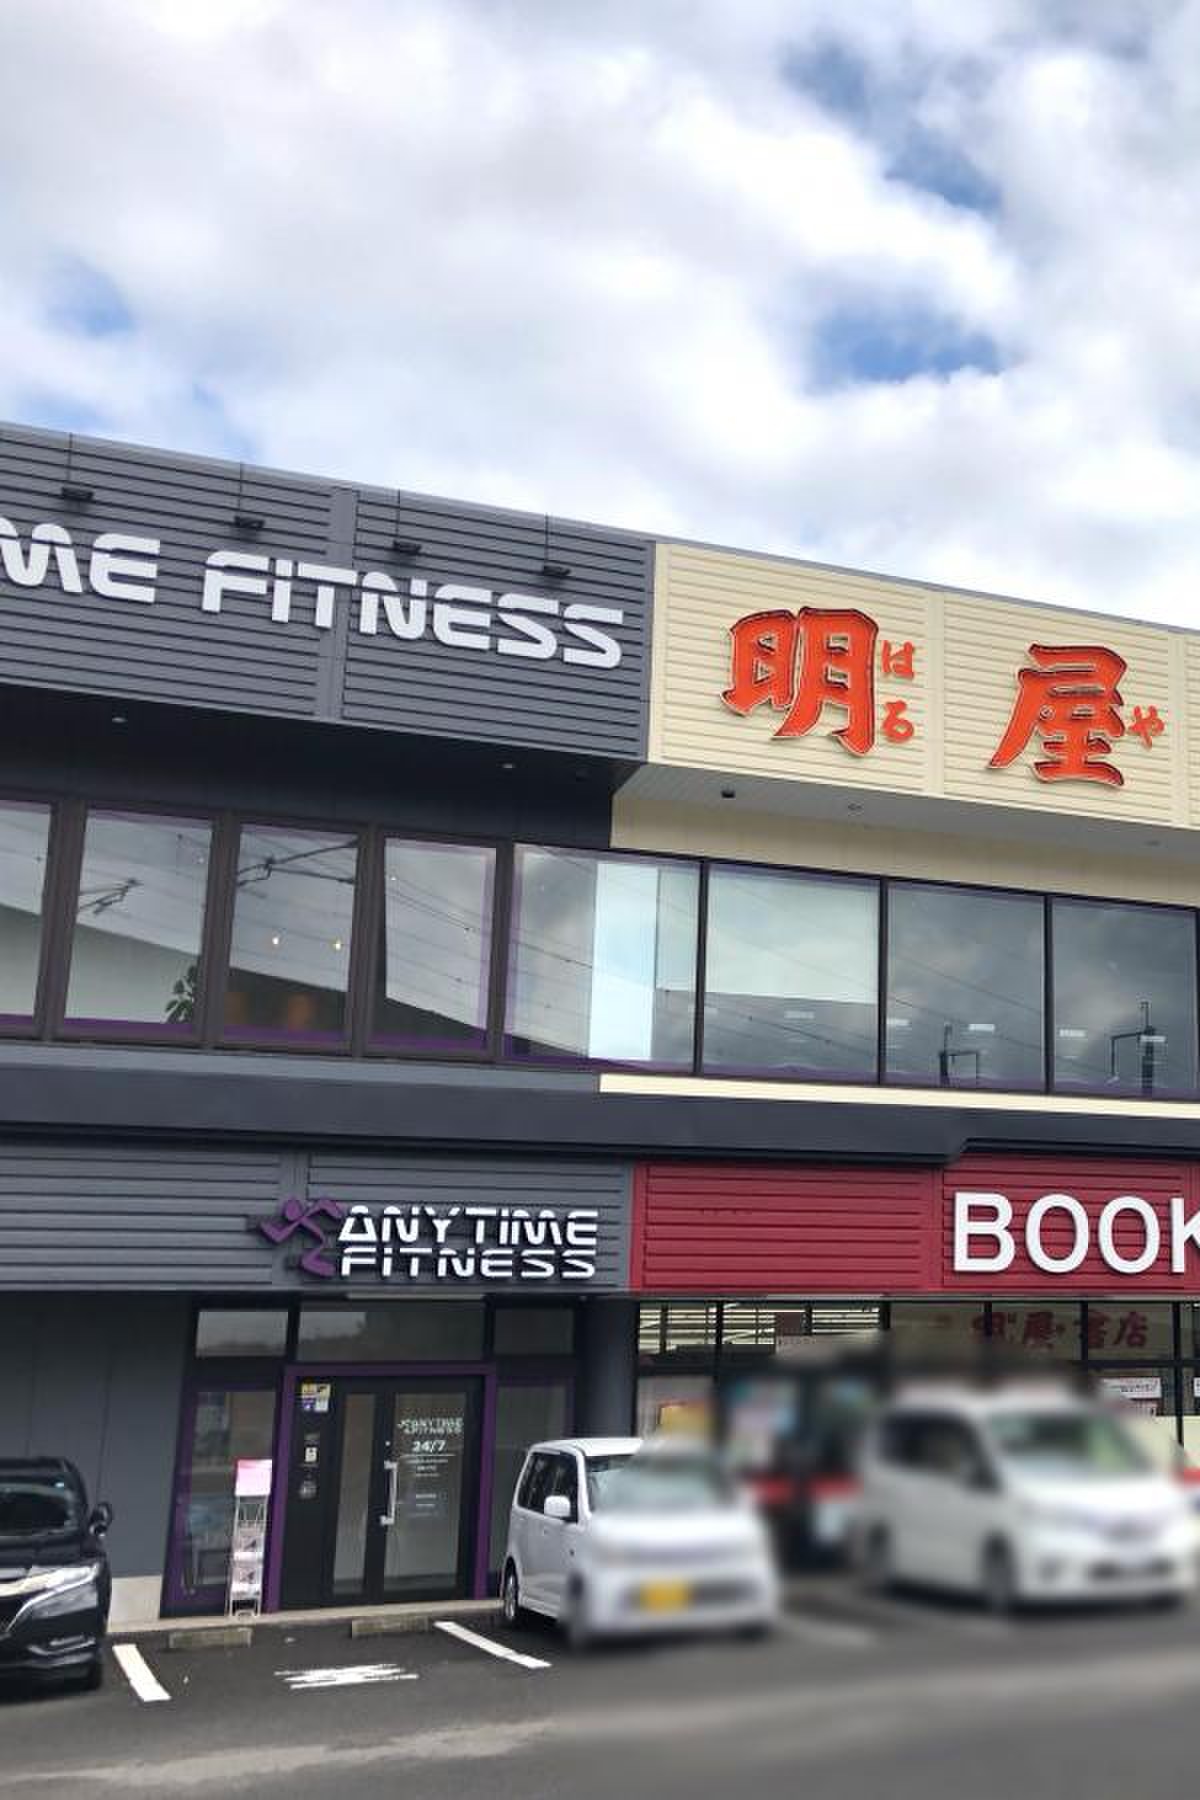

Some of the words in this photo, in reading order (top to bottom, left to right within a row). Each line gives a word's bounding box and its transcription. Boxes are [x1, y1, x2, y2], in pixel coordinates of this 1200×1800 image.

[0, 517, 161, 603] ME
[202, 550, 624, 669] FITNESS
[338, 1205, 599, 1246] ANYTIME
[340, 1247, 597, 1279] FITNESS
